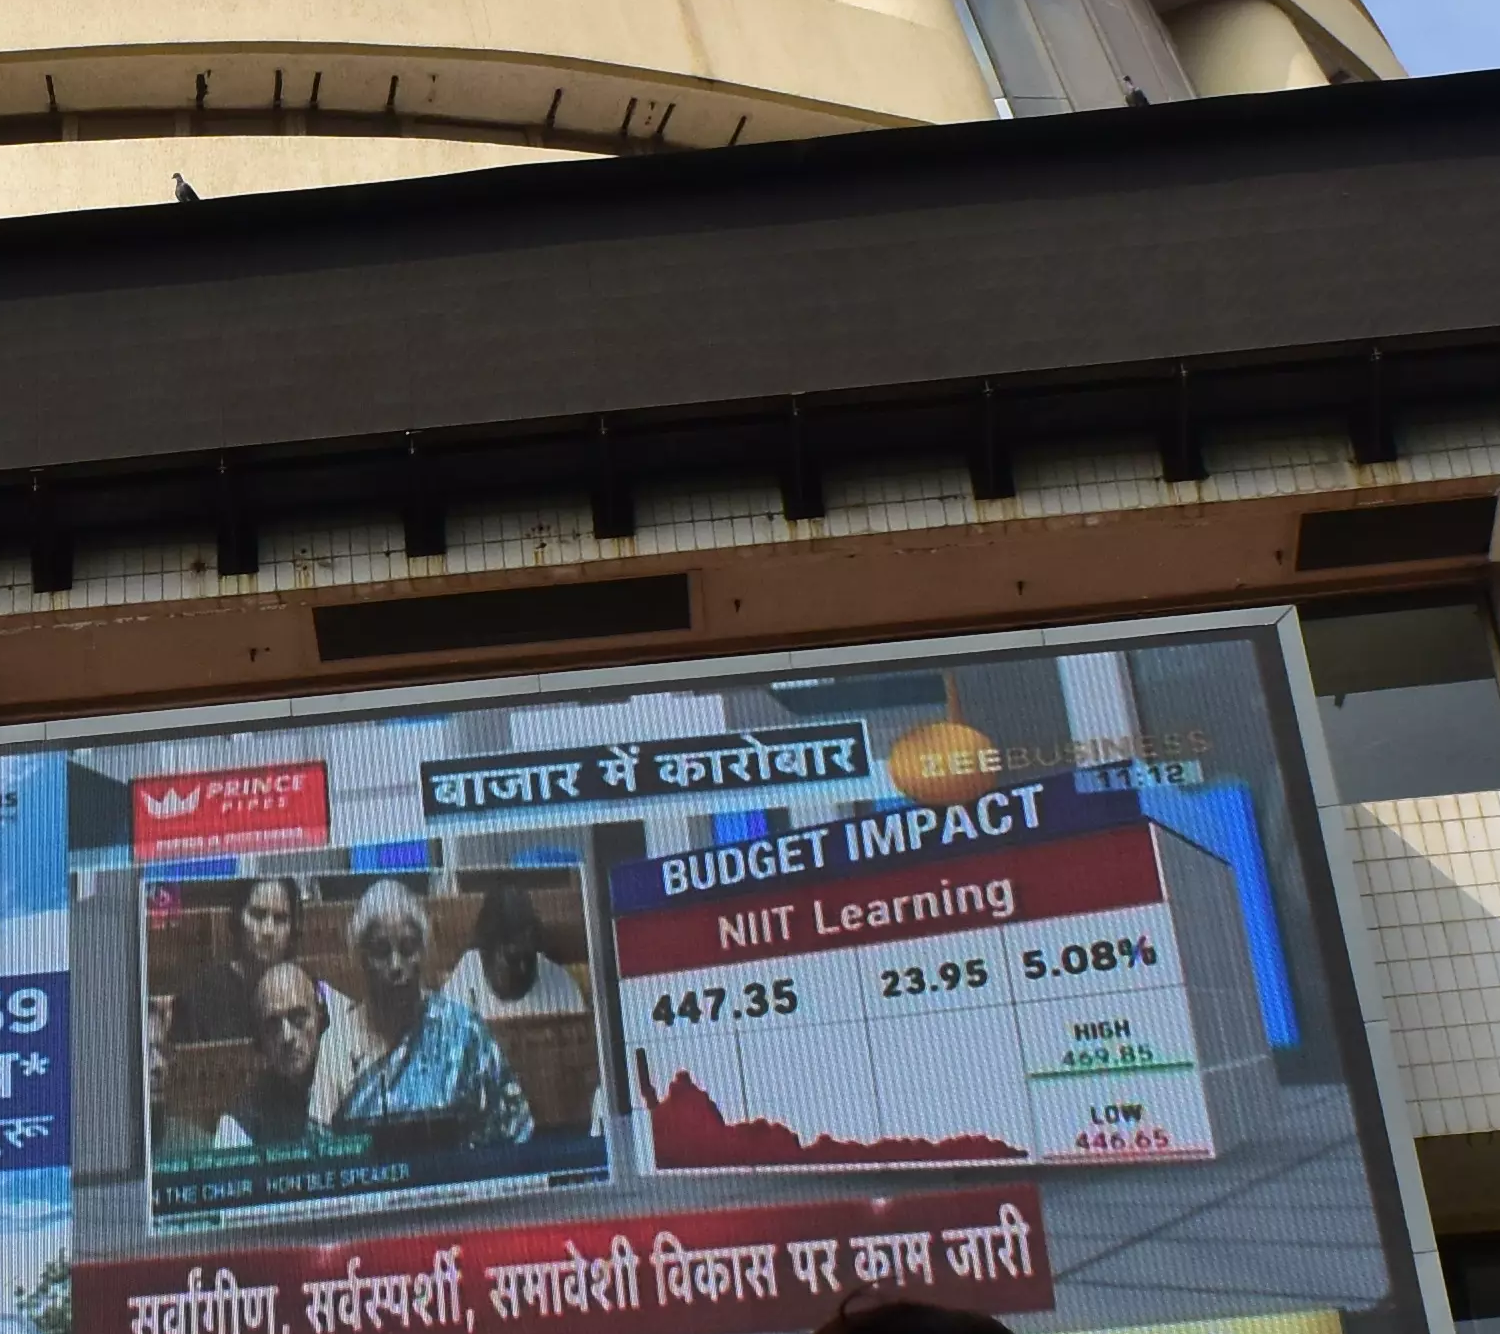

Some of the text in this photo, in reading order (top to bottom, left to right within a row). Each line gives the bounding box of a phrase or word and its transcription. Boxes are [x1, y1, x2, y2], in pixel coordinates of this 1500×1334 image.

[206, 773, 308, 799] PRINCE
[430, 735, 860, 811] बाजार में कारोबार
[662, 784, 1045, 897] BUDGET IMPACT
[717, 878, 1016, 951] NIIT Learning
[880, 958, 990, 999] 23.95
[1022, 935, 1158, 981] 5.08%
[652, 978, 799, 1028] 447.35
[1073, 1019, 1132, 1042] HIGH
[1062, 1043, 1154, 1067] 469.85
[1090, 1103, 1143, 1125] LOW
[485, 1234, 640, 1320] समावेशी
[650, 1229, 780, 1308] विकास
[786, 1237, 843, 1297] पर
[849, 1230, 935, 1289] काम
[941, 1202, 1034, 1284] जारी
